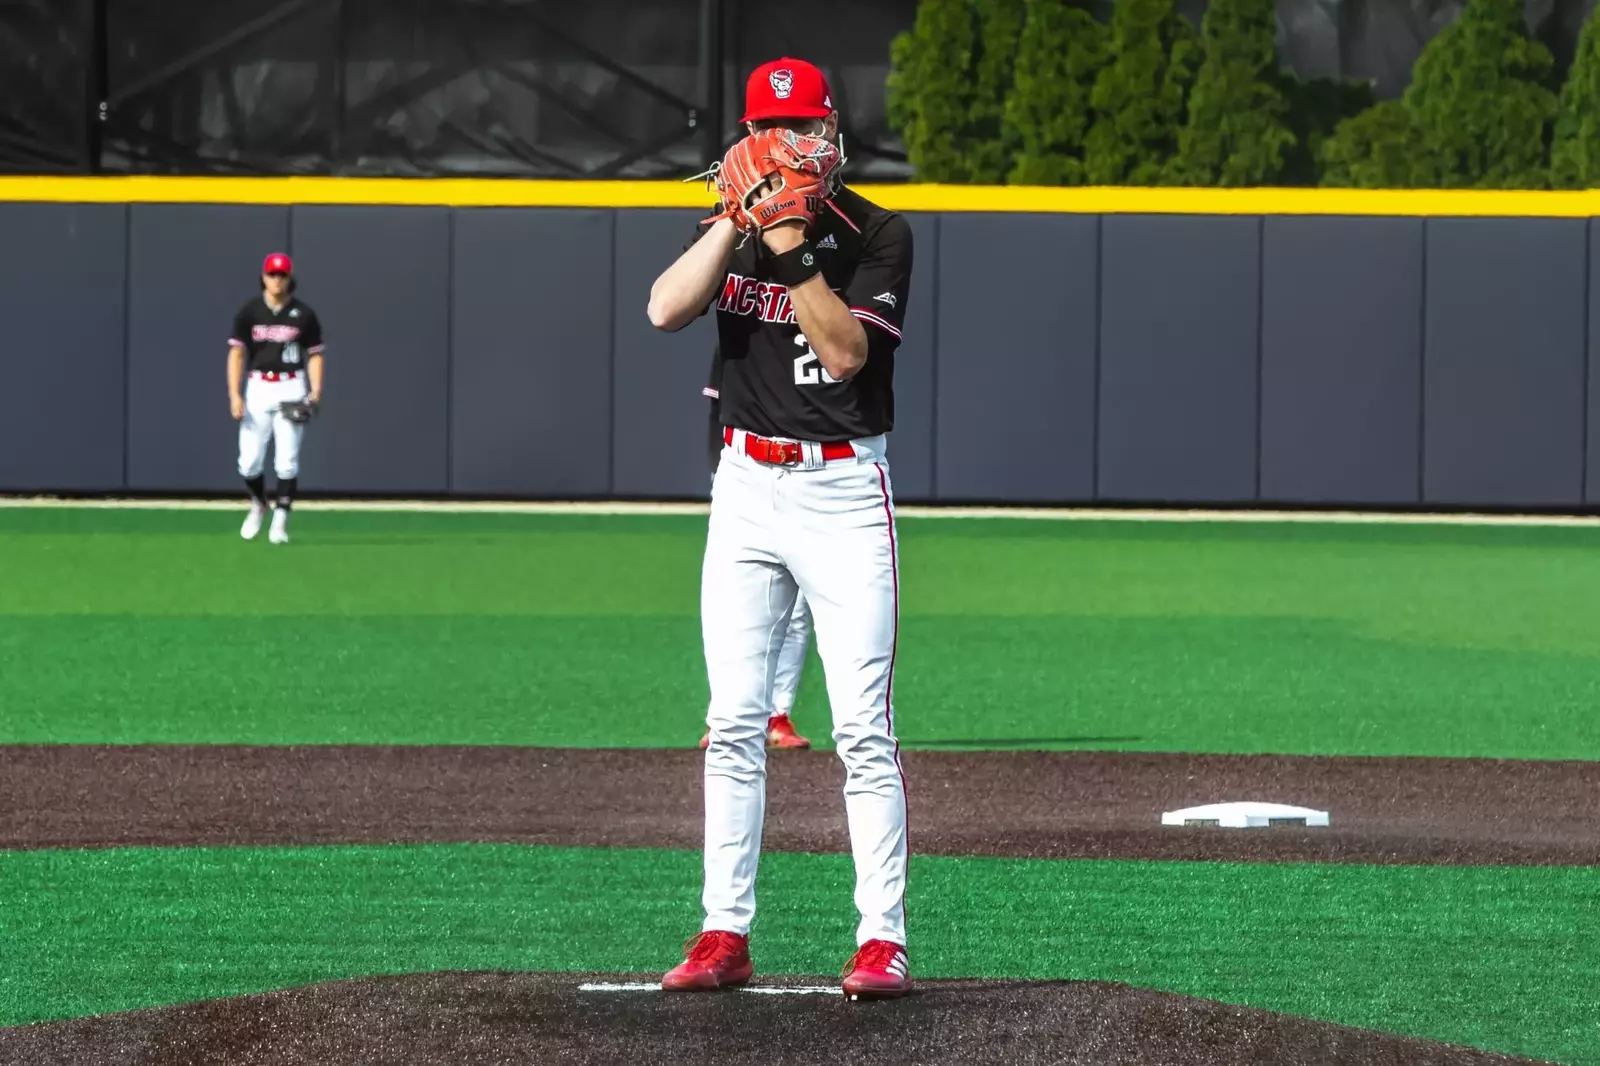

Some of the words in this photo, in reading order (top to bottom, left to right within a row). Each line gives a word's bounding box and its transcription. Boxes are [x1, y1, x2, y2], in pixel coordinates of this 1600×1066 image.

[760, 200, 797, 220] Wilson
[717, 273, 799, 324] NCSTA
[794, 333, 844, 385] 2
